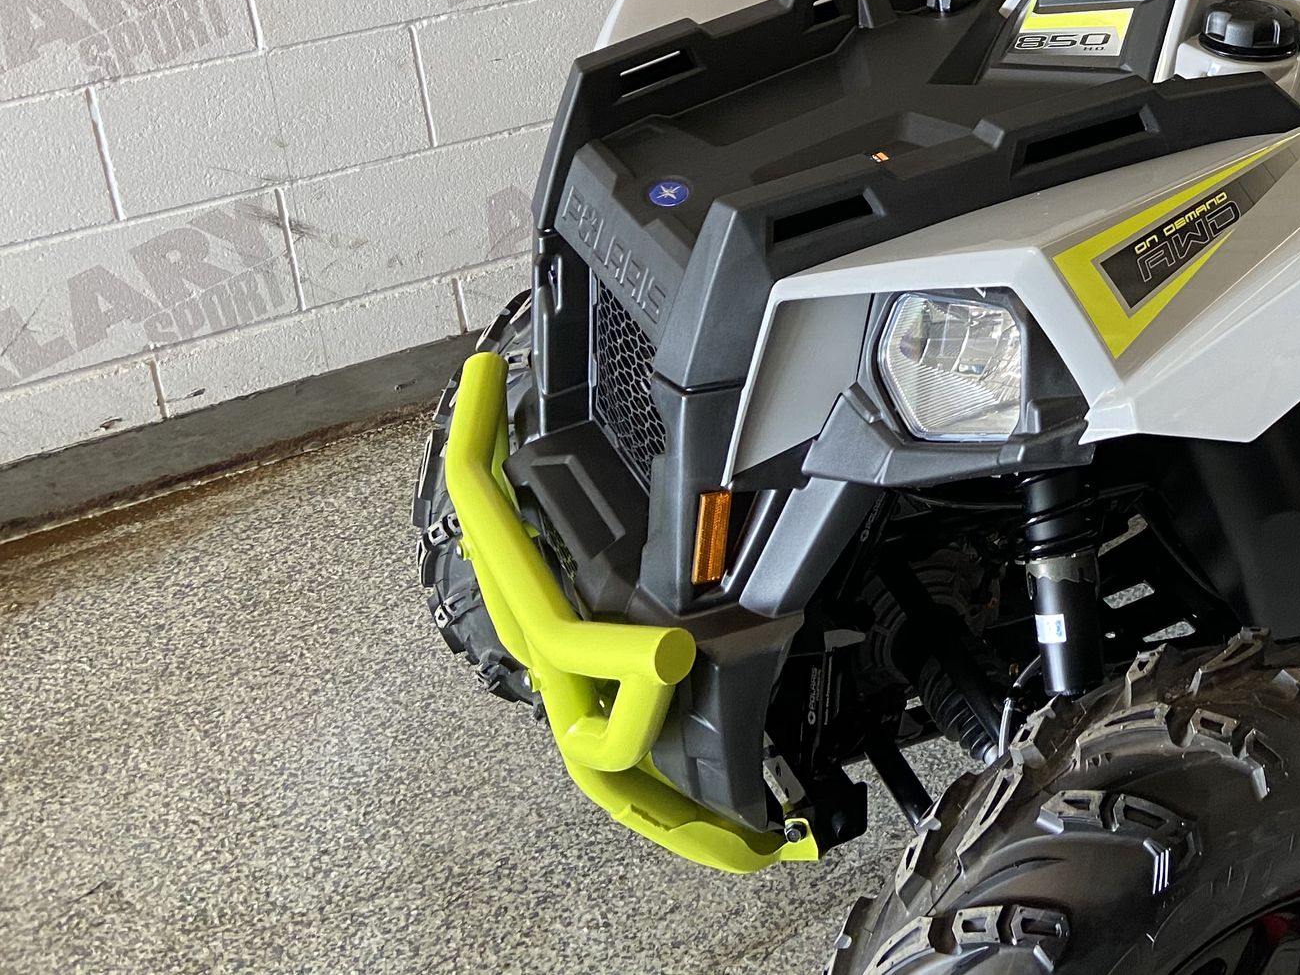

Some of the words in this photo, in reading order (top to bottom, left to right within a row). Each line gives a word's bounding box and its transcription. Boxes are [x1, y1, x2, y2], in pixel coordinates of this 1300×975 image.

[1015, 32, 1111, 50] 850
[561, 184, 667, 325] POLARIS
[1137, 200, 1241, 283] AWD
